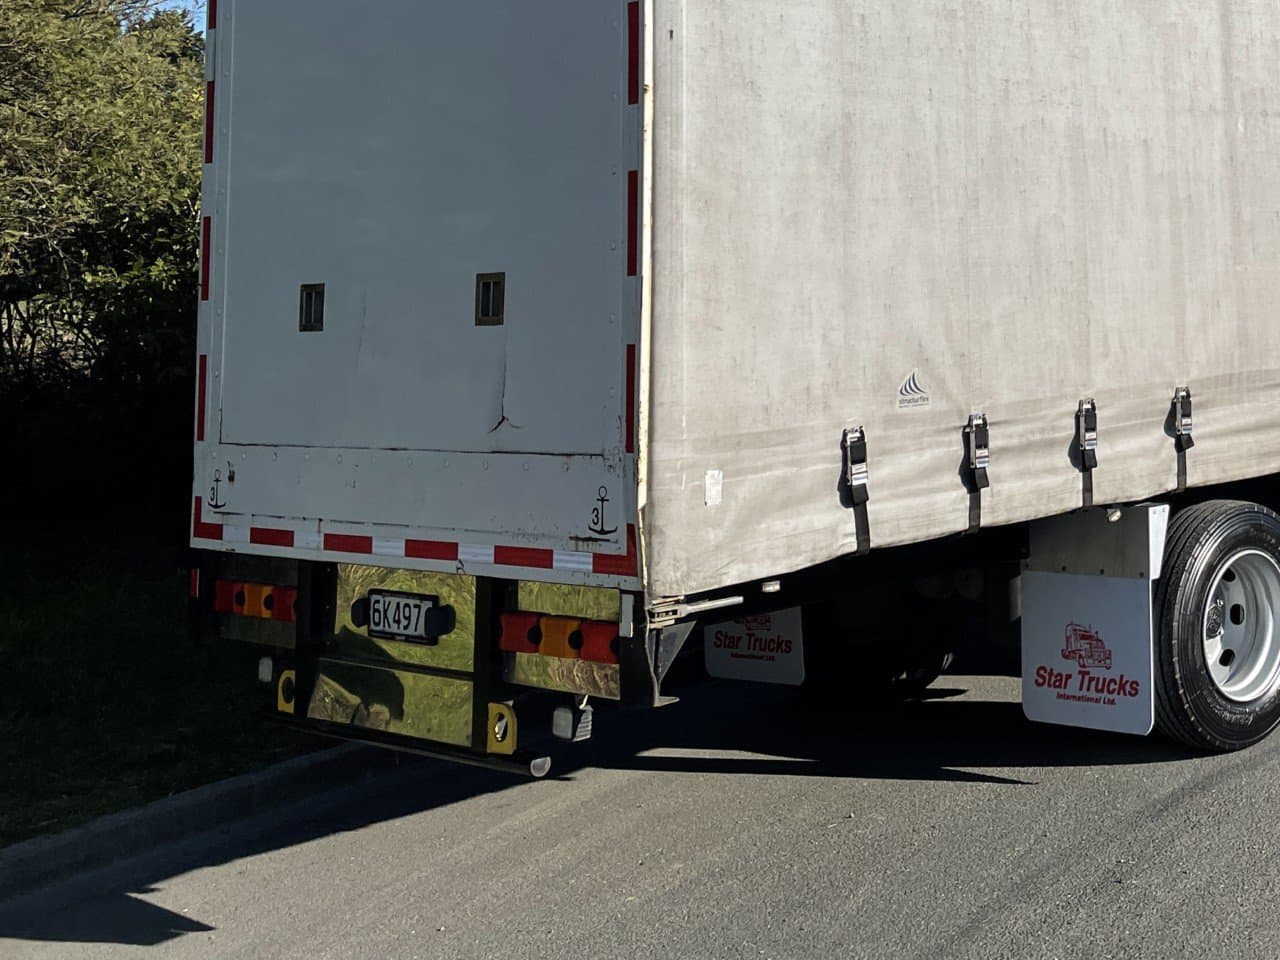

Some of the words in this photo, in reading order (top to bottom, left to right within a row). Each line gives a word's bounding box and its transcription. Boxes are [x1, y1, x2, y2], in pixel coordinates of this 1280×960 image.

[210, 486, 216, 502] 3
[592, 507, 599, 526] 3
[372, 599, 422, 633] 6K497
[713, 630, 742, 650] Star
[745, 632, 793, 654] Trucks
[1034, 665, 1073, 690] Star
[1077, 669, 1140, 697] Trucks
[1055, 691, 1102, 704] International
[1102, 696, 1117, 706] Ltd.
